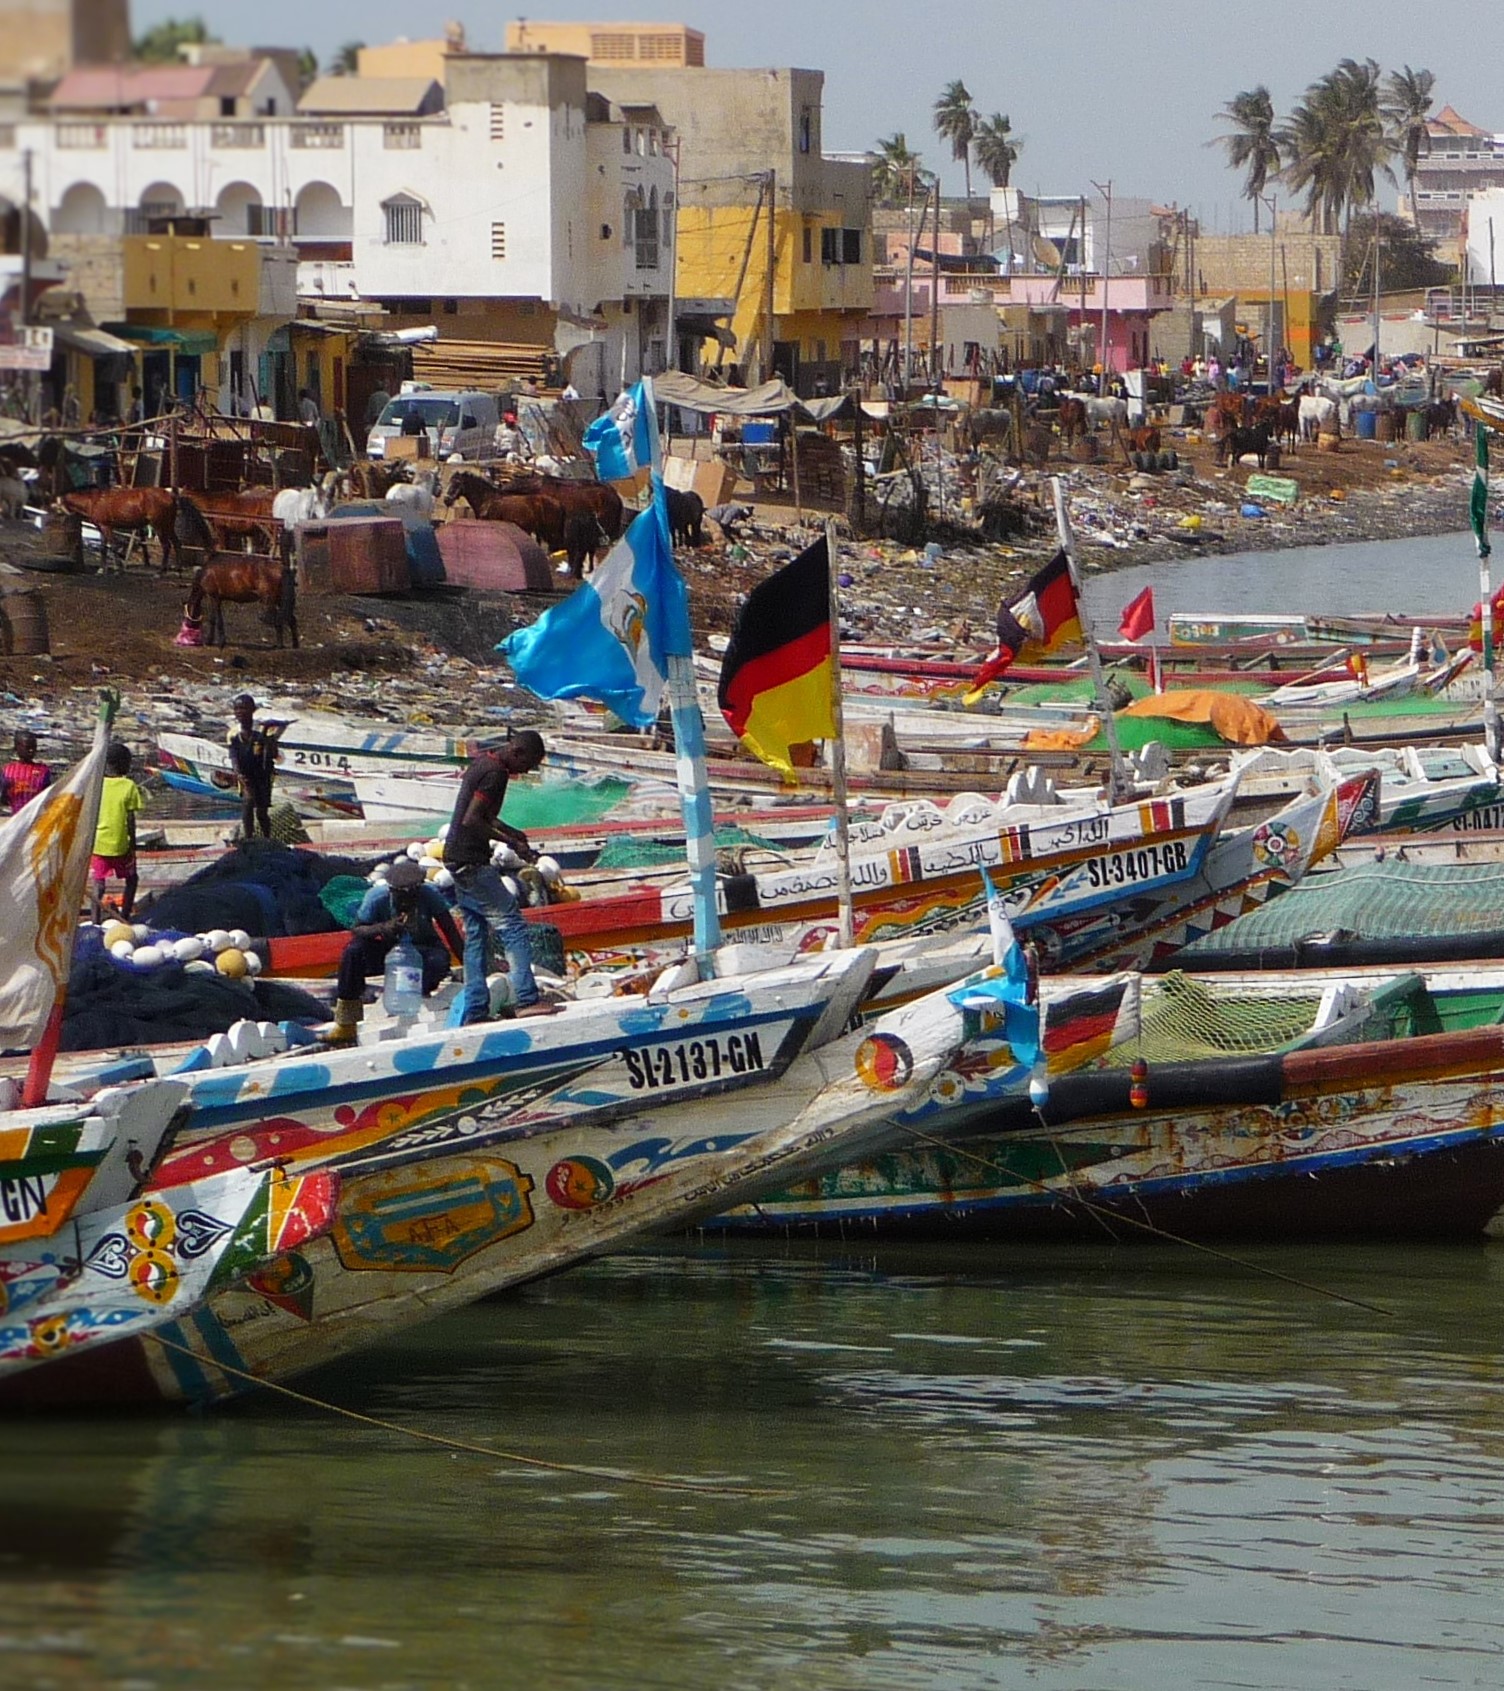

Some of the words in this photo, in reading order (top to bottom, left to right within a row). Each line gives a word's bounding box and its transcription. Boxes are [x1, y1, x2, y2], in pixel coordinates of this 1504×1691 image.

[294, 751, 352, 772] 2014
[1087, 841, 1188, 888] SL-3407-GB
[625, 1031, 764, 1089] SL-2137-GN
